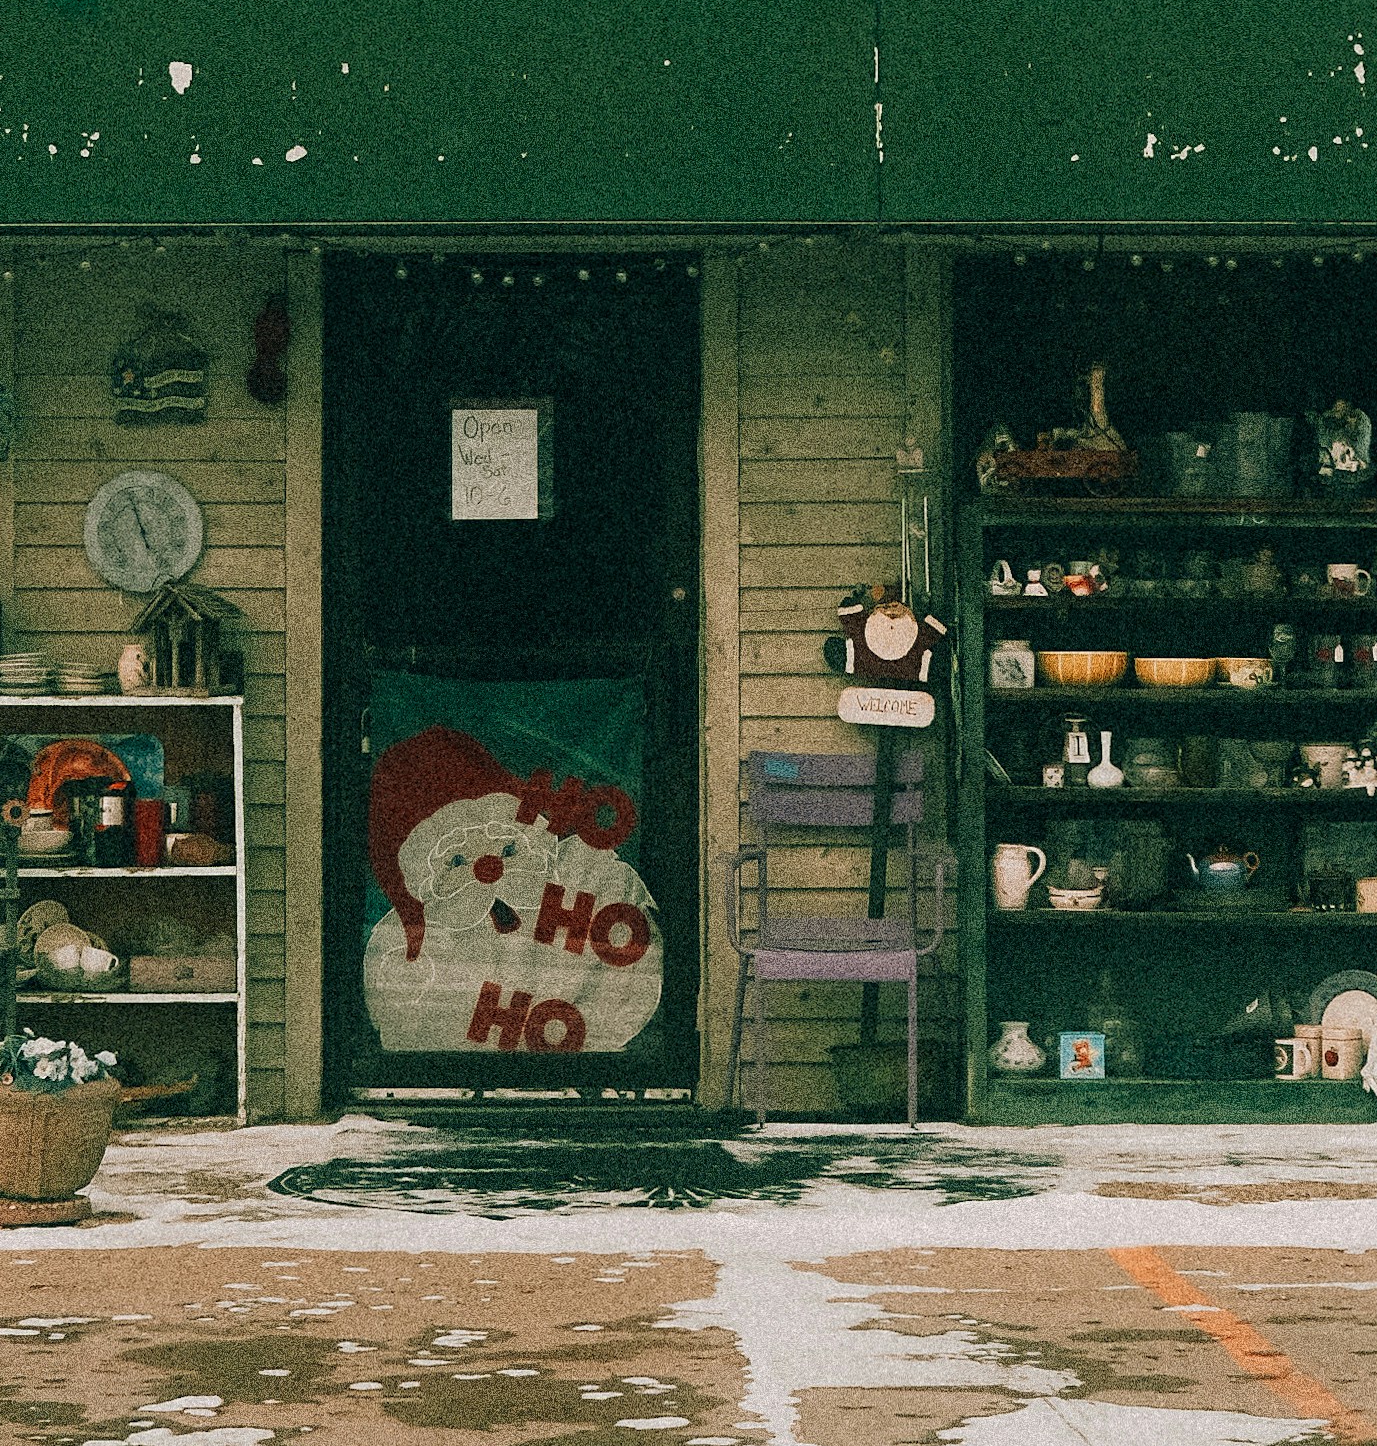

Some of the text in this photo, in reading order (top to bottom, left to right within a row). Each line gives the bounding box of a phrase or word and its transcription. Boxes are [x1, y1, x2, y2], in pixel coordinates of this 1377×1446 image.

[464, 415, 513, 442] Open
[458, 444, 492, 465] Wed
[482, 464, 509, 479] Sat
[465, 485, 512, 506] 10-6
[856, 694, 918, 716] WELCOME
[515, 767, 638, 850] HO
[534, 882, 652, 967] HO
[466, 981, 586, 1052] HO
